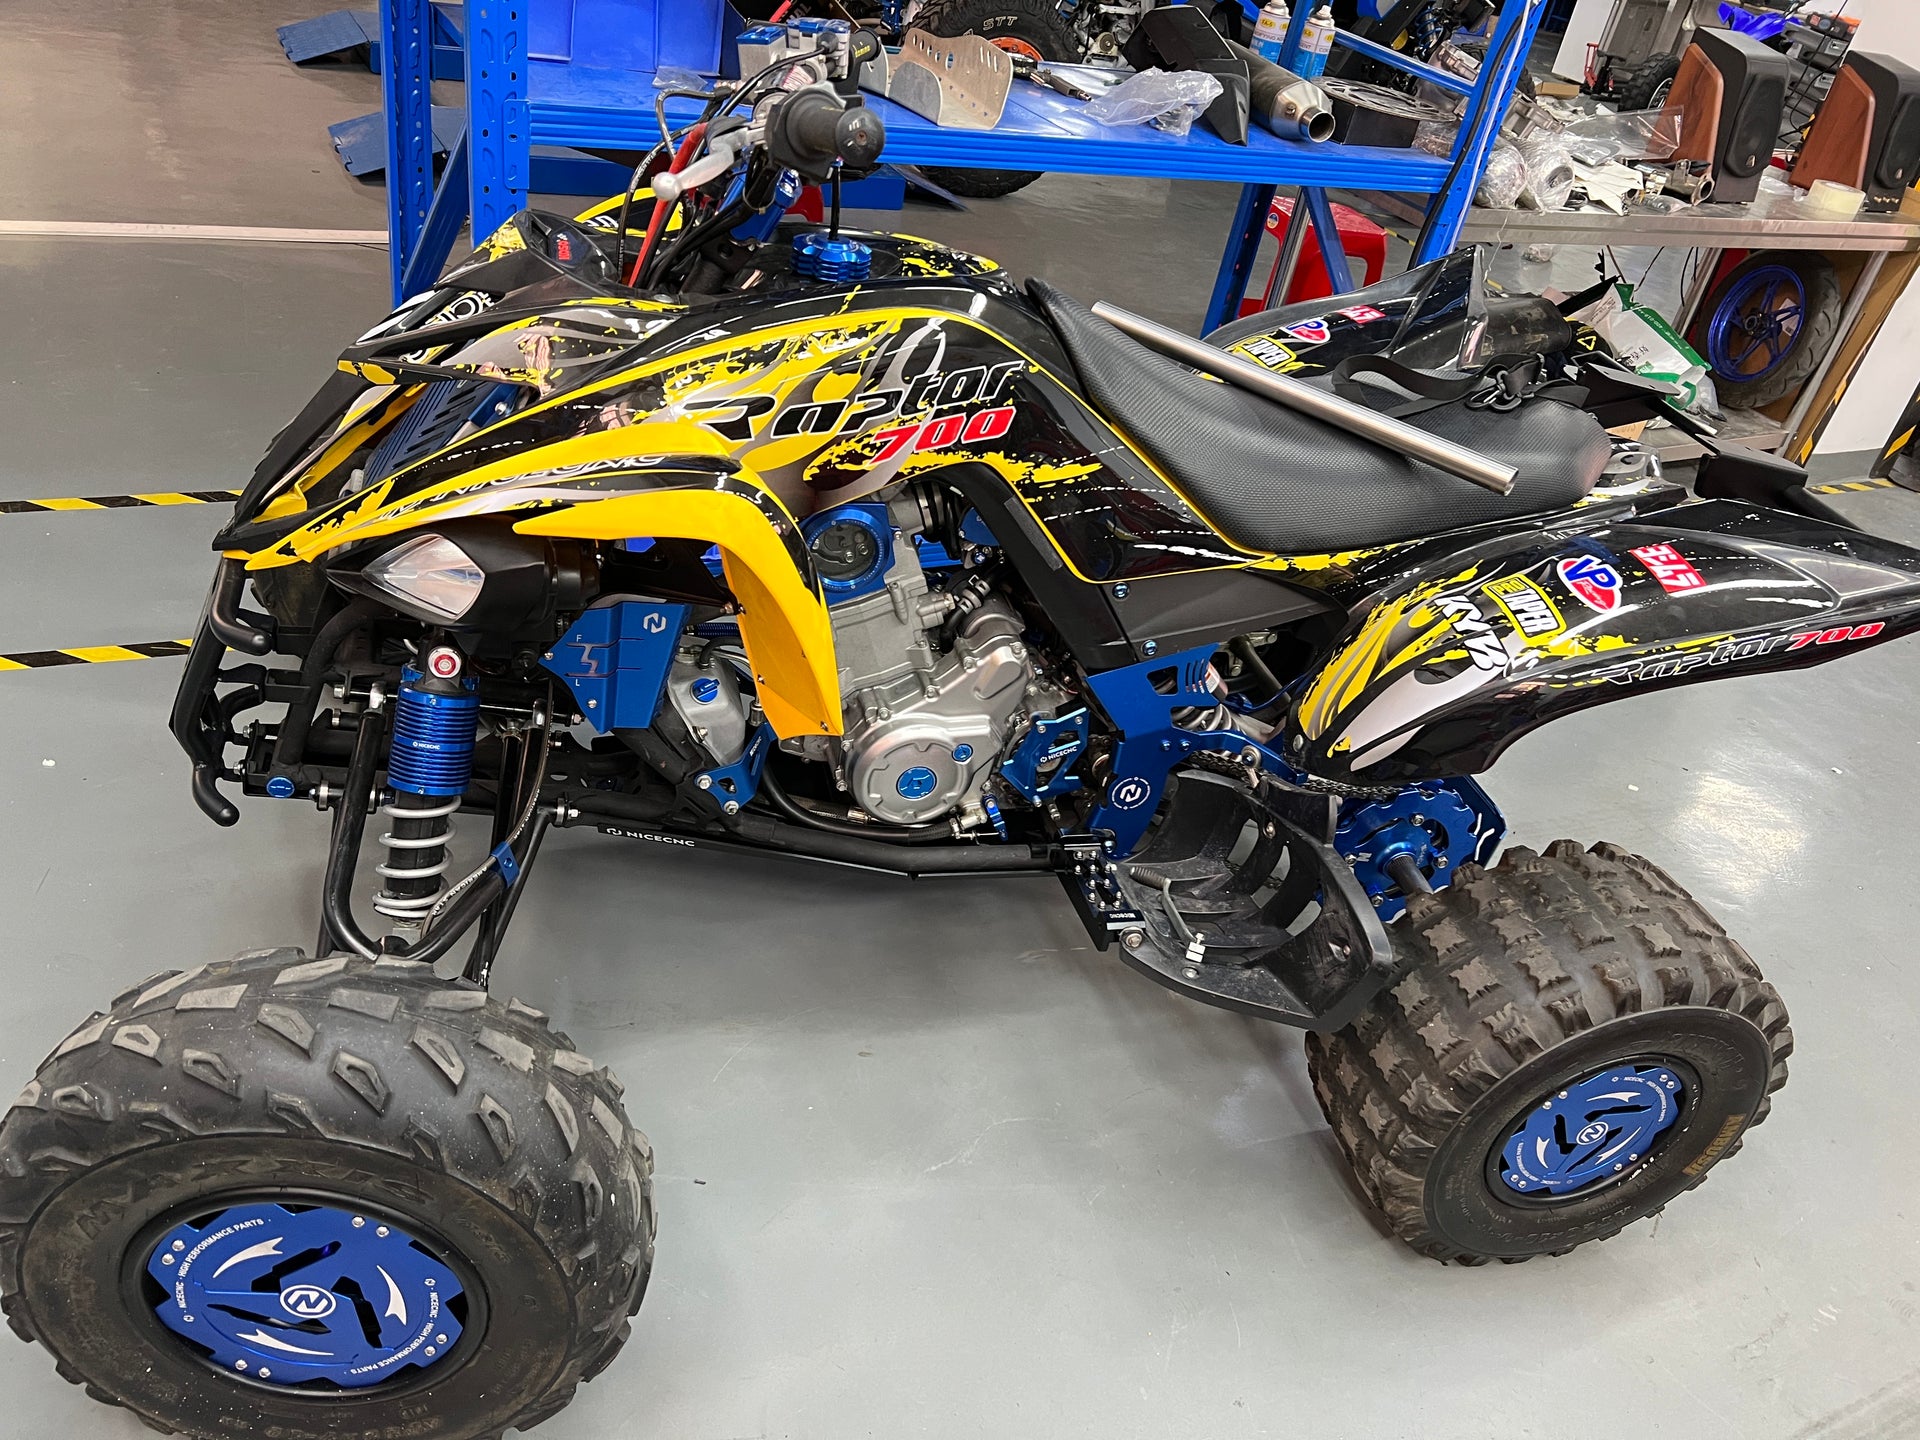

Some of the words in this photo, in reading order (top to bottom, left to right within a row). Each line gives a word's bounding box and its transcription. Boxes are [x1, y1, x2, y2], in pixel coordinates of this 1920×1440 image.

[982, 15, 1018, 31] STT
[868, 406, 1018, 466] 700
[1564, 557, 1617, 589] VP
[1489, 578, 1528, 596] PRO
[1502, 588, 1559, 634] TAPER
[576, 634, 583, 642] F
[1433, 595, 1511, 673] KYB
[1784, 620, 1887, 652] 700
[575, 678, 580, 687] L
[1047, 745, 1078, 760] NICECNC
[626, 830, 696, 847] NICECNC
[234, 1218, 265, 1232] PARTS
[185, 1227, 235, 1263] PERFORMANCE
[177, 1260, 191, 1277] HIGH
[175, 1281, 187, 1309] NICECNC
[350, 1363, 379, 1375] PARTS
